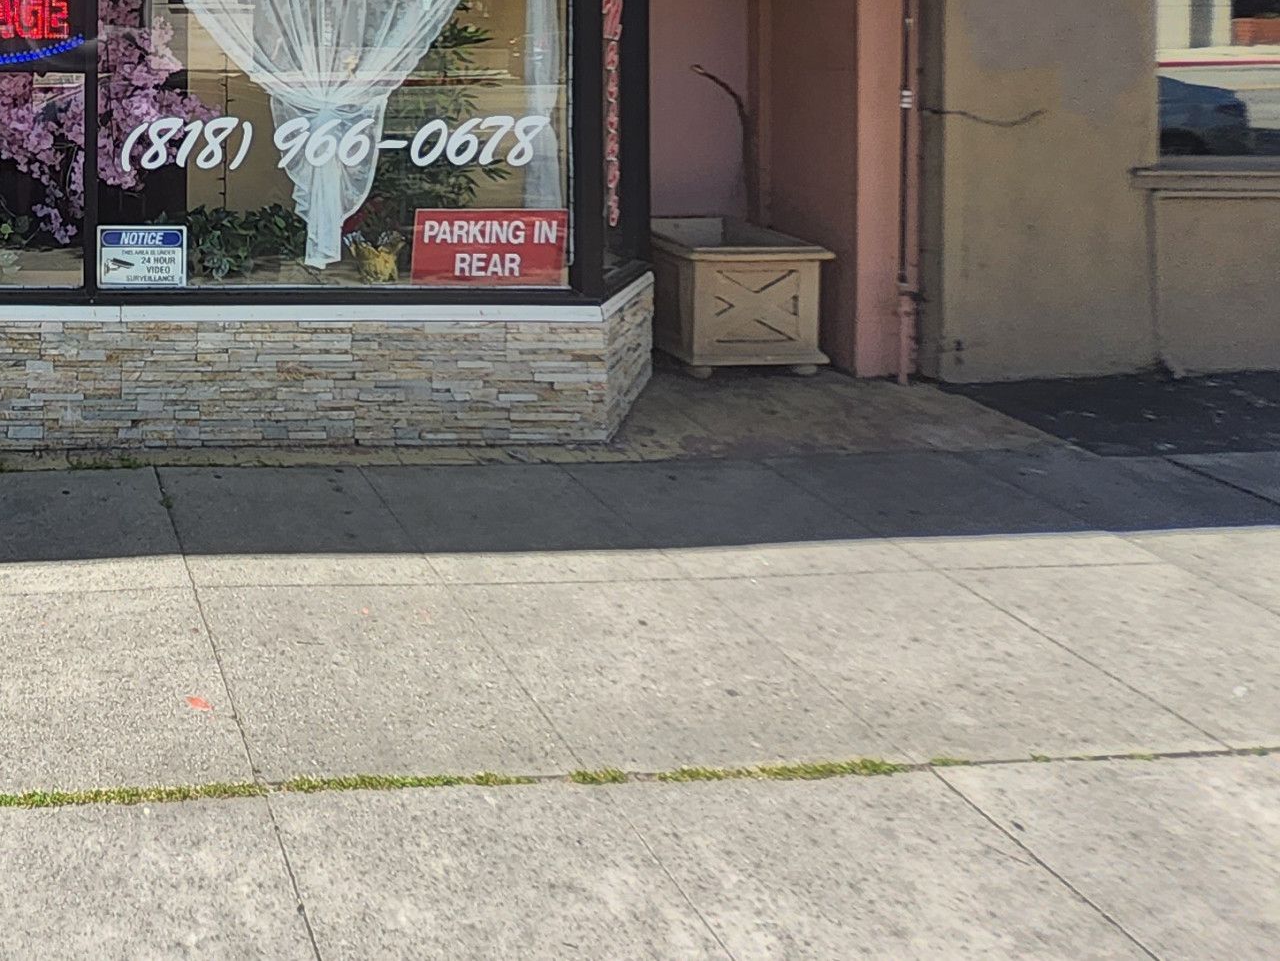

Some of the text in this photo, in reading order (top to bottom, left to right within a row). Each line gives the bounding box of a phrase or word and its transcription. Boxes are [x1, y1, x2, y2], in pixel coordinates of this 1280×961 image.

[120, 114, 551, 172] (818) 966-0678
[120, 232, 164, 245] NOTICE
[423, 219, 558, 246] PARKING IN
[141, 256, 176, 265] 24 HOUR
[146, 266, 170, 274] VIDEO
[454, 253, 522, 278] REAR
